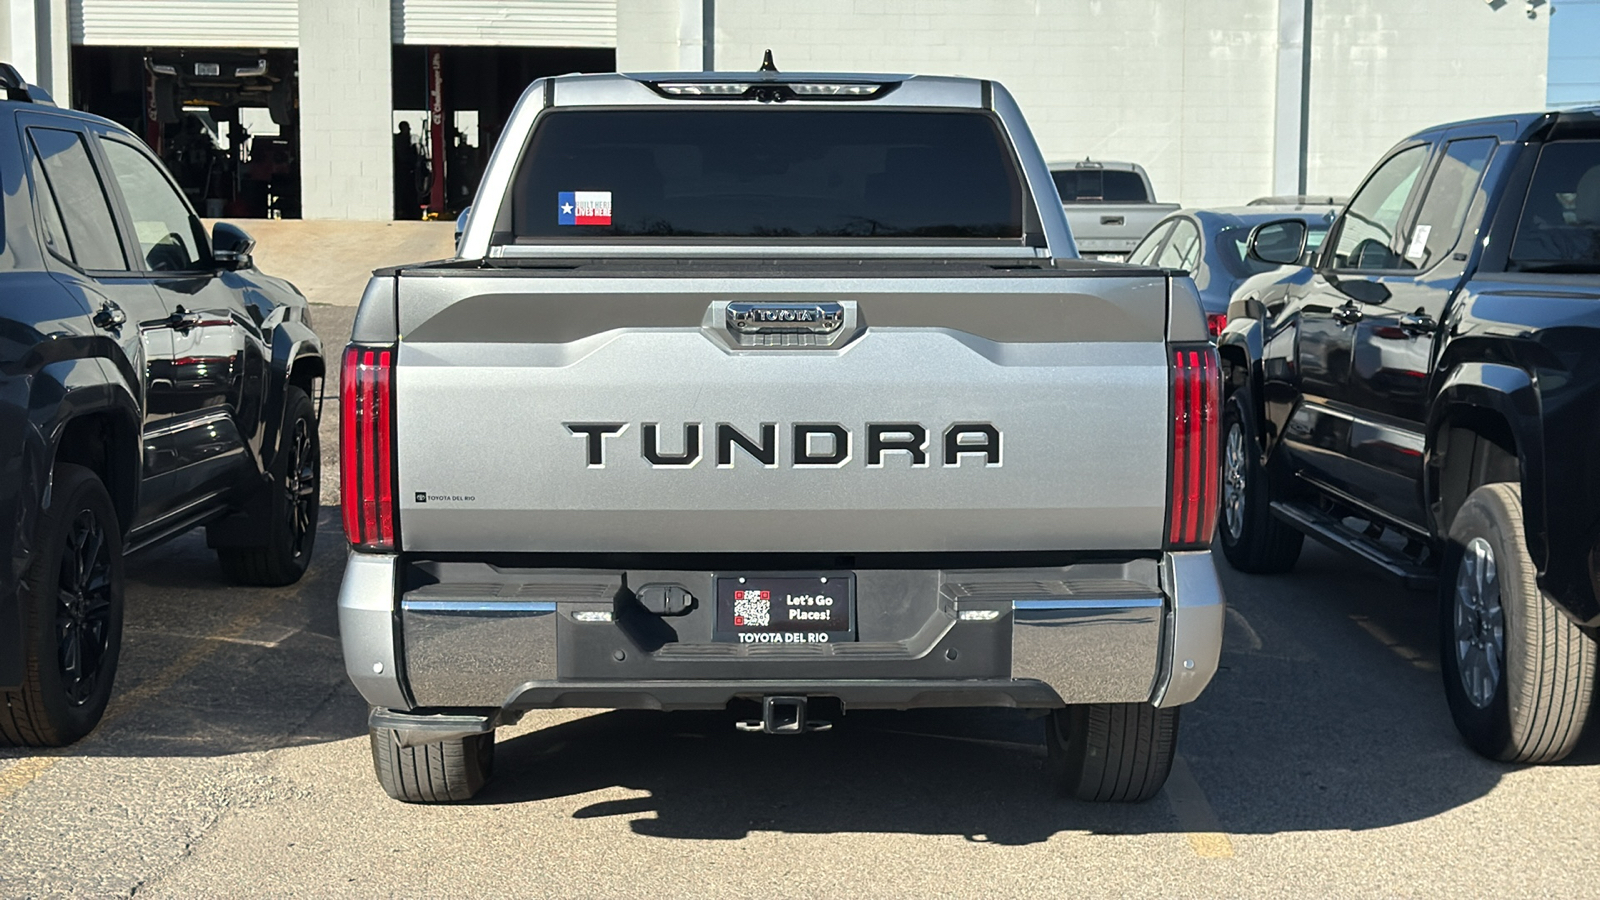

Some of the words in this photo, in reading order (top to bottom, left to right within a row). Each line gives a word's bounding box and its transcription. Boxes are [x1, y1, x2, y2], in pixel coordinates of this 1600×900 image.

[575, 207, 593, 216] LIVES
[595, 207, 611, 216] HERE
[759, 309, 813, 321] TOYOTA
[561, 421, 1003, 469] TUNDRA
[786, 595, 814, 606] Let's
[815, 595, 833, 606] Go
[789, 609, 831, 620] Places!
[738, 633, 782, 643] TOYOTA
[785, 633, 806, 643] DEL
[808, 633, 829, 643] RIO
